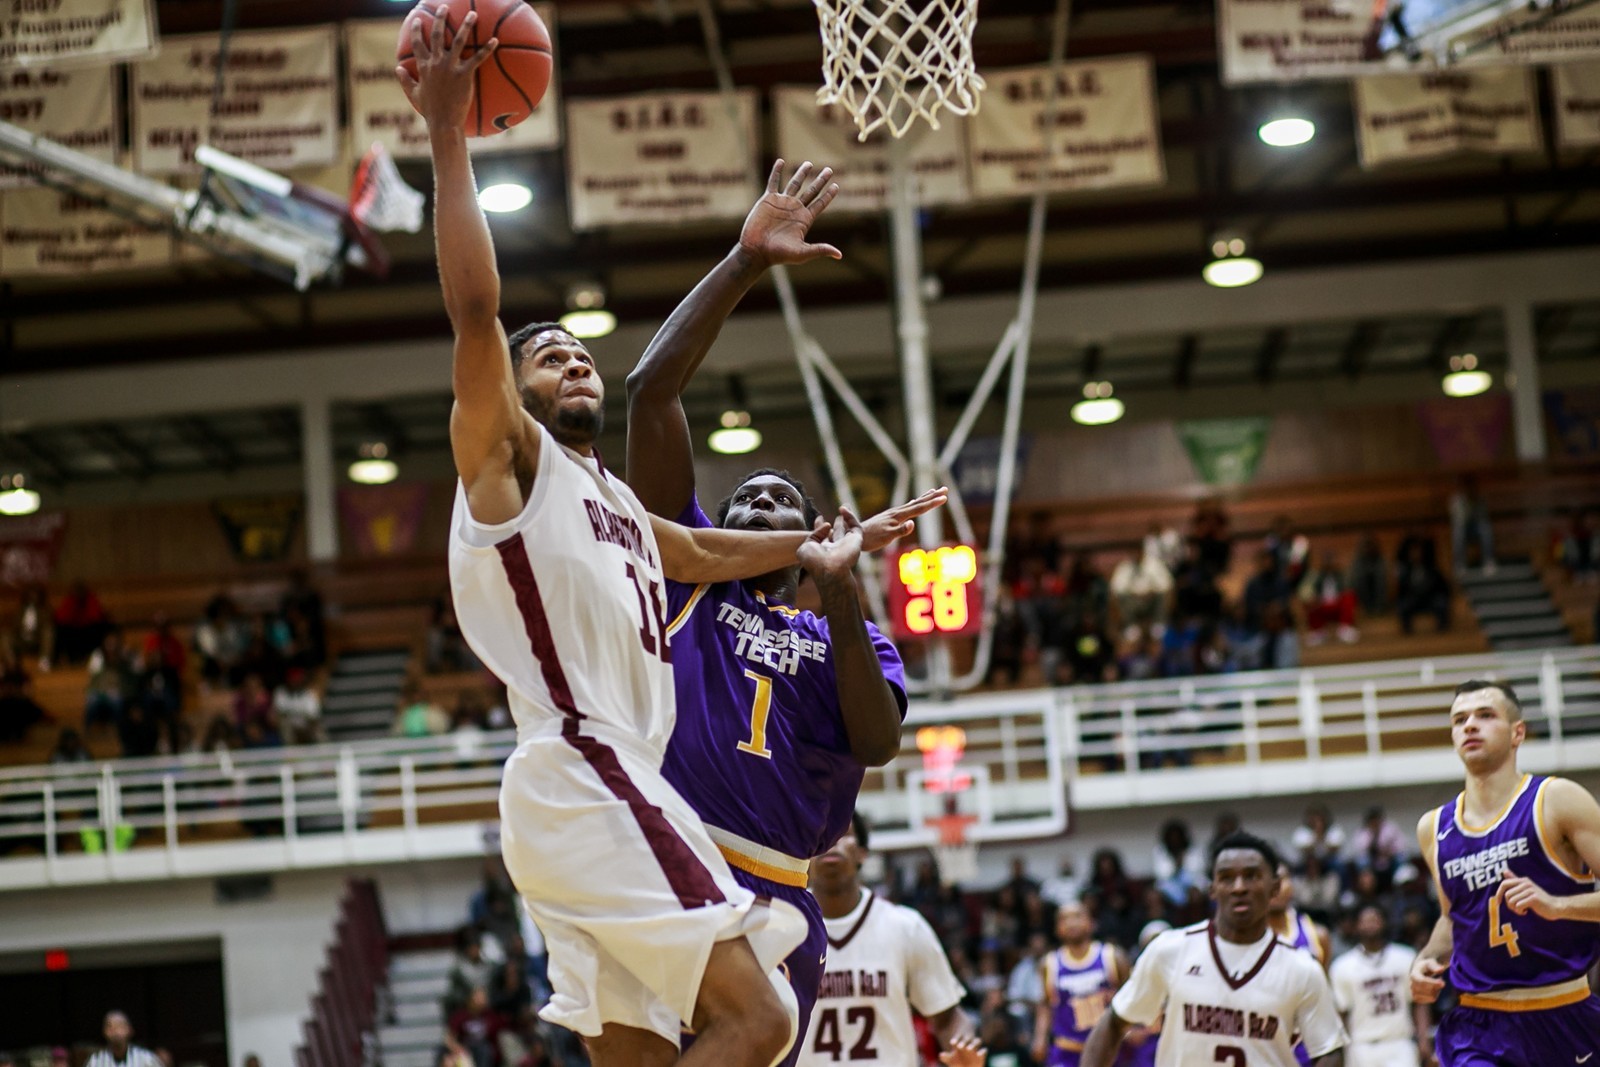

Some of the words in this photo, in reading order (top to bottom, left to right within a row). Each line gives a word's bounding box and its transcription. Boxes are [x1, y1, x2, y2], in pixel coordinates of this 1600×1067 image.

[716, 602, 827, 663] TENNESSEE
[734, 632, 800, 676] TECH
[736, 668, 773, 760] 1
[1443, 837, 1530, 880] TENNESSEE
[1463, 860, 1509, 892] TECH
[1488, 895, 1521, 959] 4
[813, 1005, 878, 1062] 42
